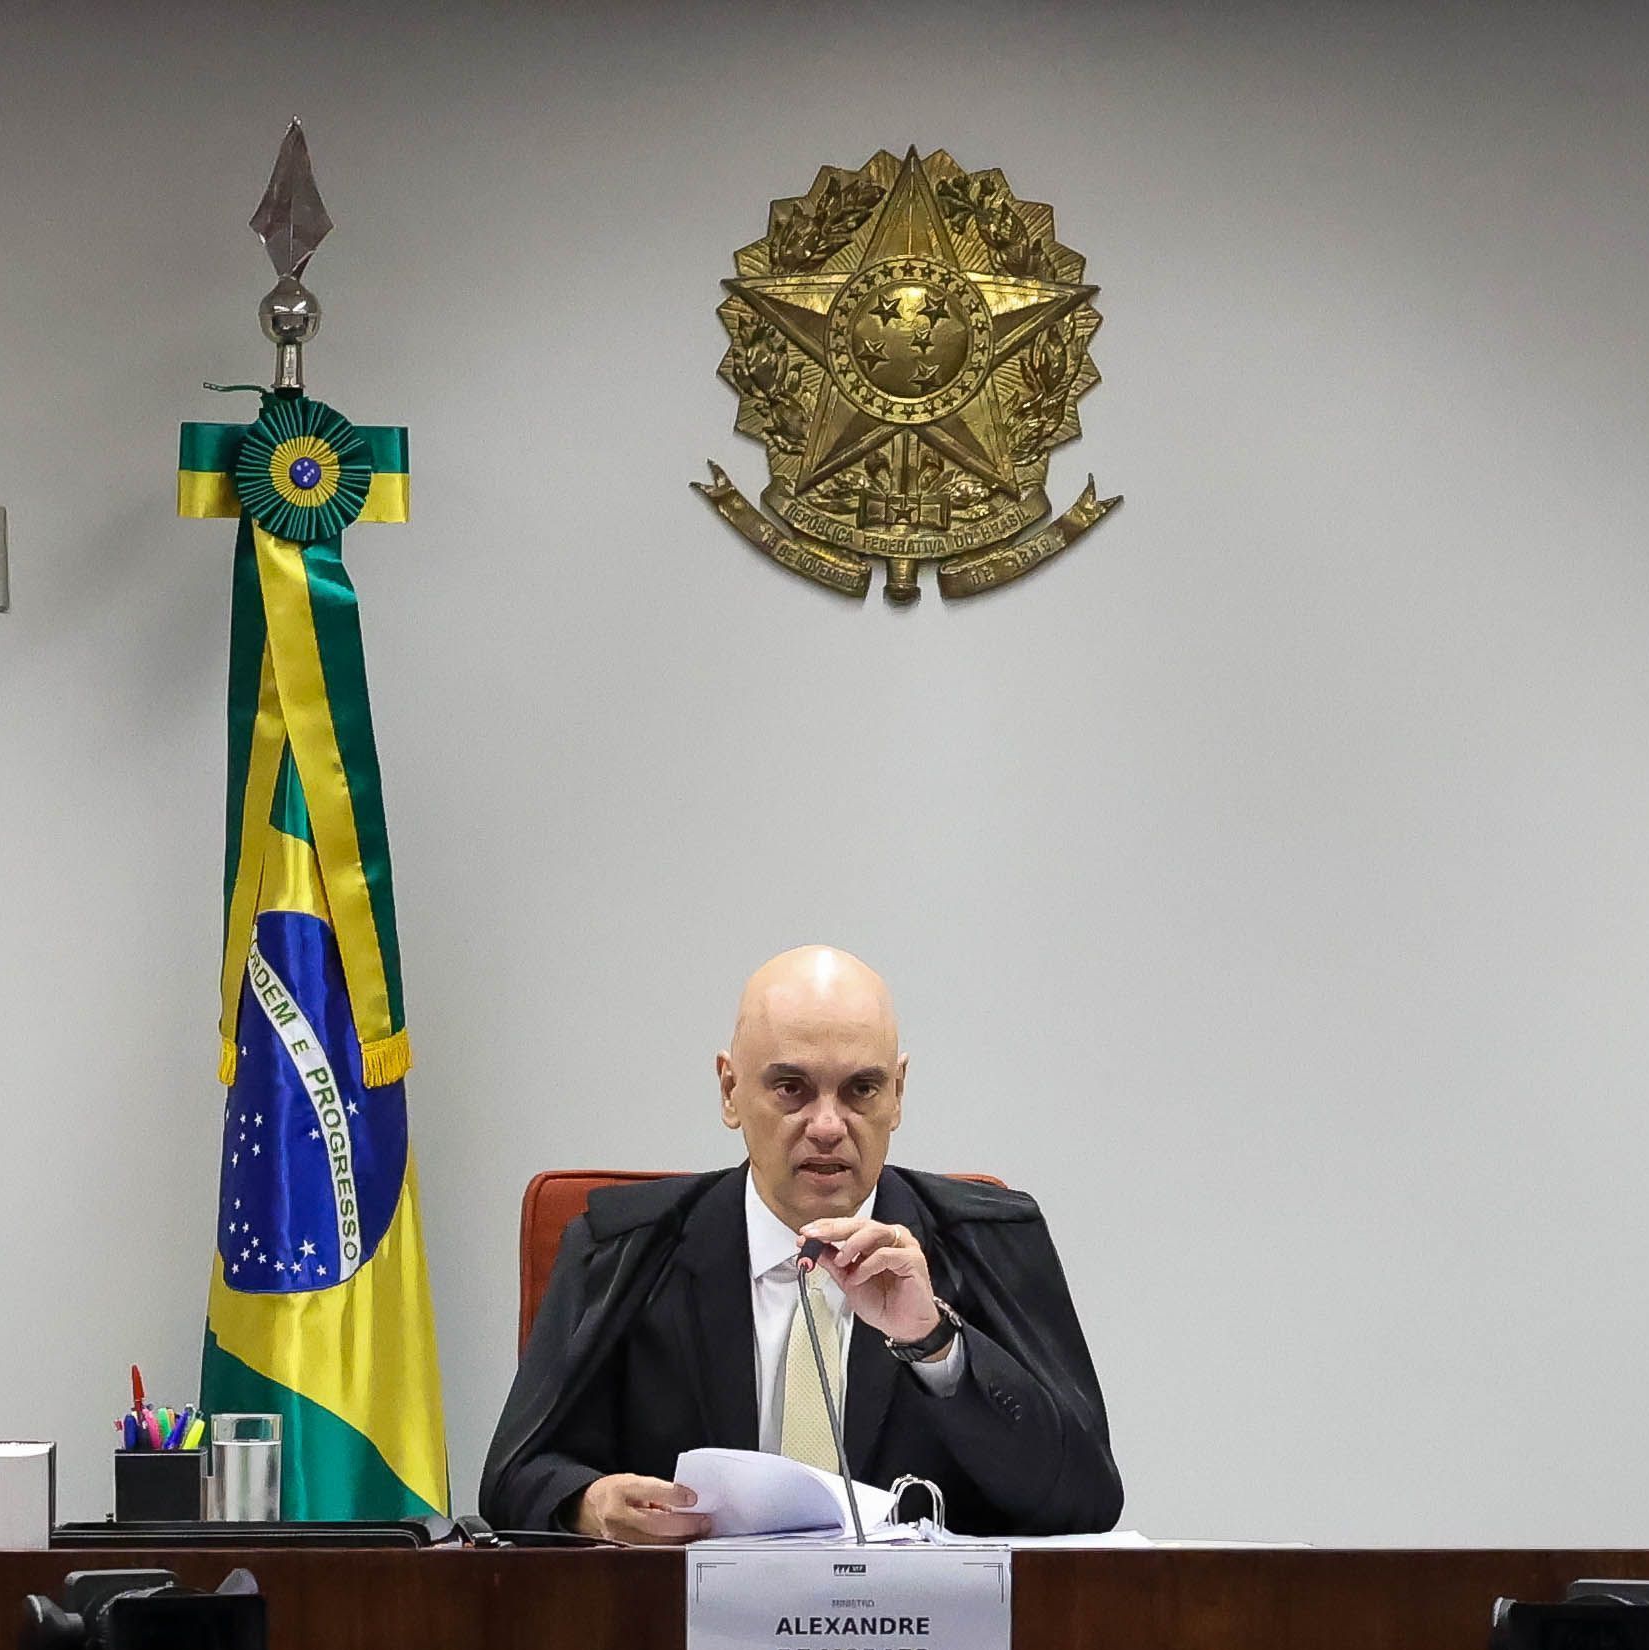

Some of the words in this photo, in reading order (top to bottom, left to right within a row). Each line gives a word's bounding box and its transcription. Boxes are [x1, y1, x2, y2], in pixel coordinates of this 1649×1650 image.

[863, 535, 948, 554] FEDERATIVA
[980, 505, 1033, 541] BRASIL
[291, 1039, 310, 1056] E
[306, 1067, 358, 1262] PROGRESSO
[775, 1616, 930, 1635] ALEXANDRE
